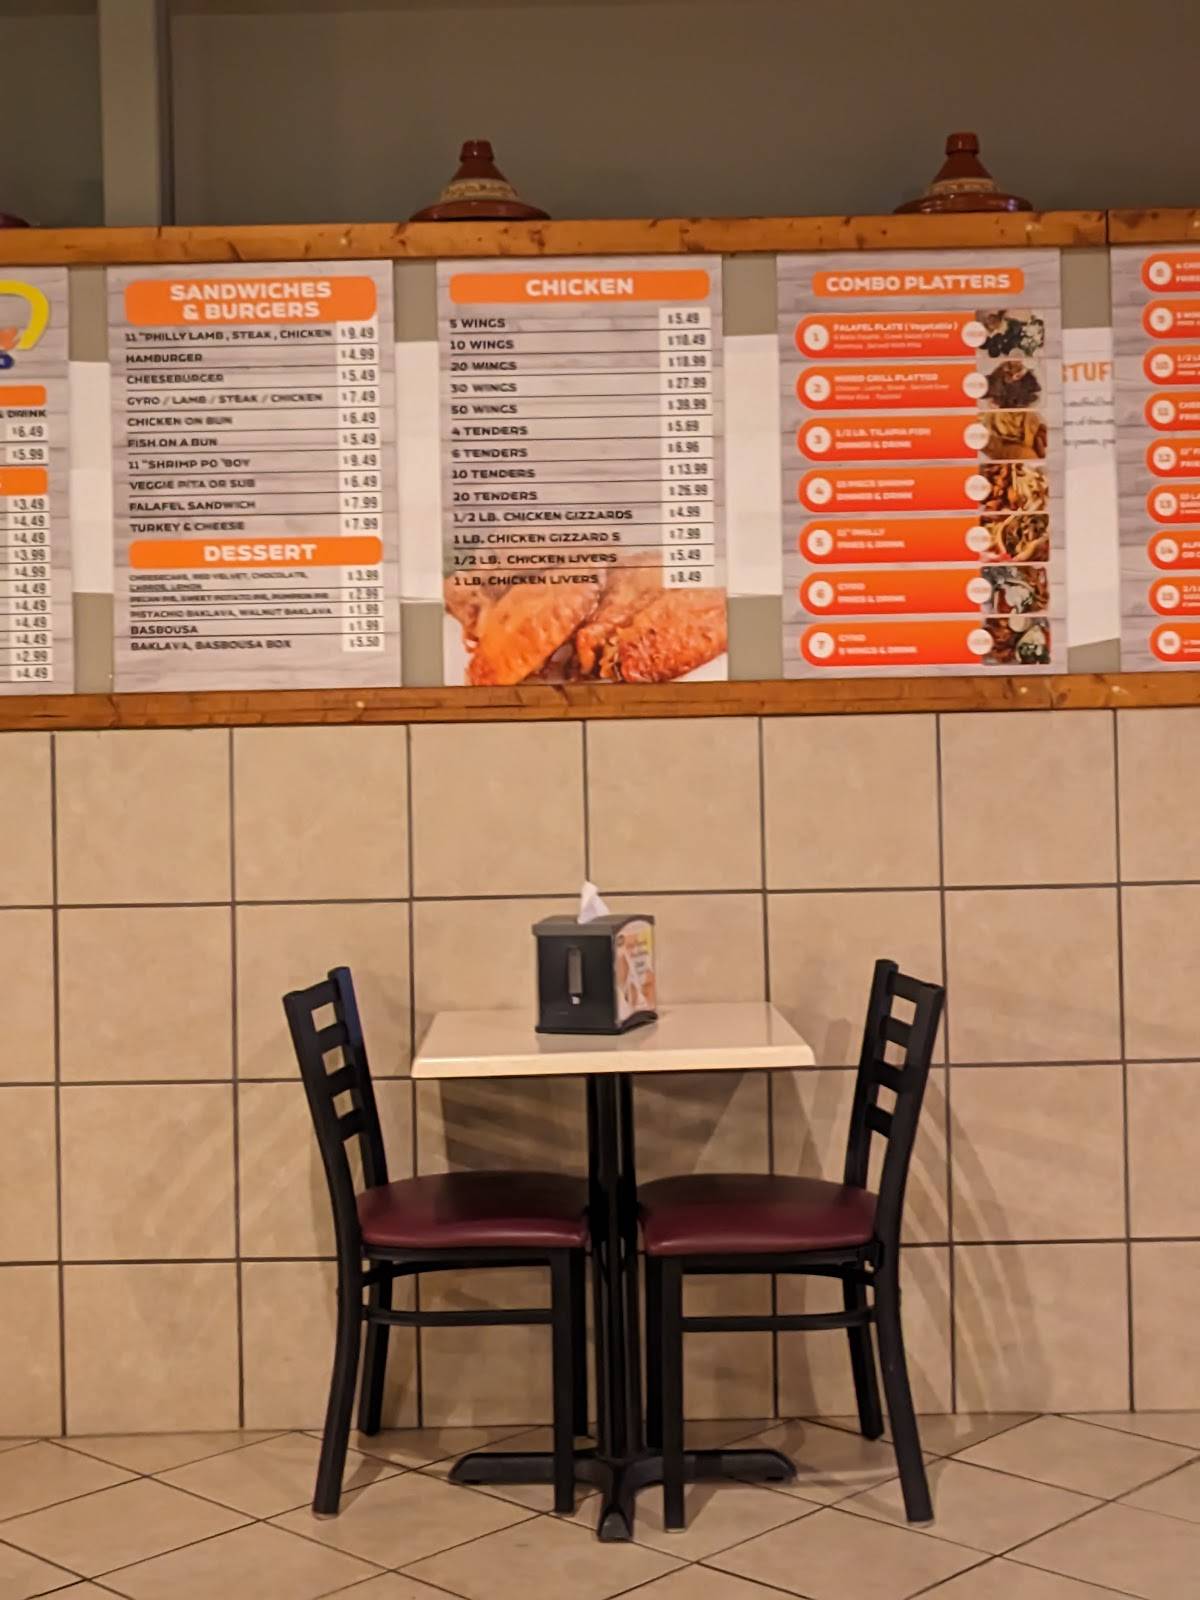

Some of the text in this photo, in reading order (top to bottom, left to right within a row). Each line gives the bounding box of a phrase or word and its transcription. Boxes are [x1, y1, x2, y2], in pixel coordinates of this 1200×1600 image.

[526, 278, 634, 296] CHICKEN
[826, 275, 1010, 292] COMBO PLATTERS
[170, 282, 332, 301] SANDWICHES
[183, 302, 320, 320] & BURGERS
[450, 318, 506, 328] 5 WINGS
[280, 329, 332, 339] CHICKEN
[812, 332, 819, 342] 1
[450, 339, 514, 350] 10 WINGS
[126, 353, 203, 363] HAMBURGER
[450, 361, 517, 371] 20 WINGS
[1061, 362, 1114, 382] TUF
[127, 373, 224, 384] CHEESEBURGER
[451, 383, 517, 393] 30 WINGS
[813, 384, 822, 394] 2
[127, 396, 160, 406] GYRO
[172, 395, 207, 405] LAMB
[219, 394, 259, 403] STEAK
[271, 393, 323, 403] CHICKEN
[7, 410, 46, 418] DRINK
[451, 404, 517, 414] 50 WINGS
[127, 416, 233, 427] CHICKEN ON BUN
[451, 426, 528, 436] 4 TENDERS
[128, 437, 218, 449] FISH ON A BUN
[464, 448, 528, 458] TENDERS
[201, 458, 218, 468] PO
[452, 469, 536, 479] 10 TENDERS
[129, 478, 256, 490] VEGGIE PITA OR SUB
[453, 491, 538, 501] 20 TENDERS
[129, 500, 256, 511] FALAFEL SANDWICH
[454, 510, 633, 522] 1/2 LB. CHICKEN GIZZARDS
[130, 521, 245, 533] TURKEY & CHEESE
[488, 533, 546, 543] CHICKEN
[203, 544, 317, 561] DESSERT
[454, 555, 477, 565] 1/2
[507, 554, 566, 564] CHICKEN
[569, 553, 617, 563] LIVERS
[488, 575, 546, 585] CHICKEN
[550, 574, 599, 583] LIVERS
[130, 609, 183, 618] PISTACHIO
[130, 624, 198, 635] BASBOUSA
[196, 639, 264, 650] BASBOUSA
[267, 639, 292, 649] BOX
